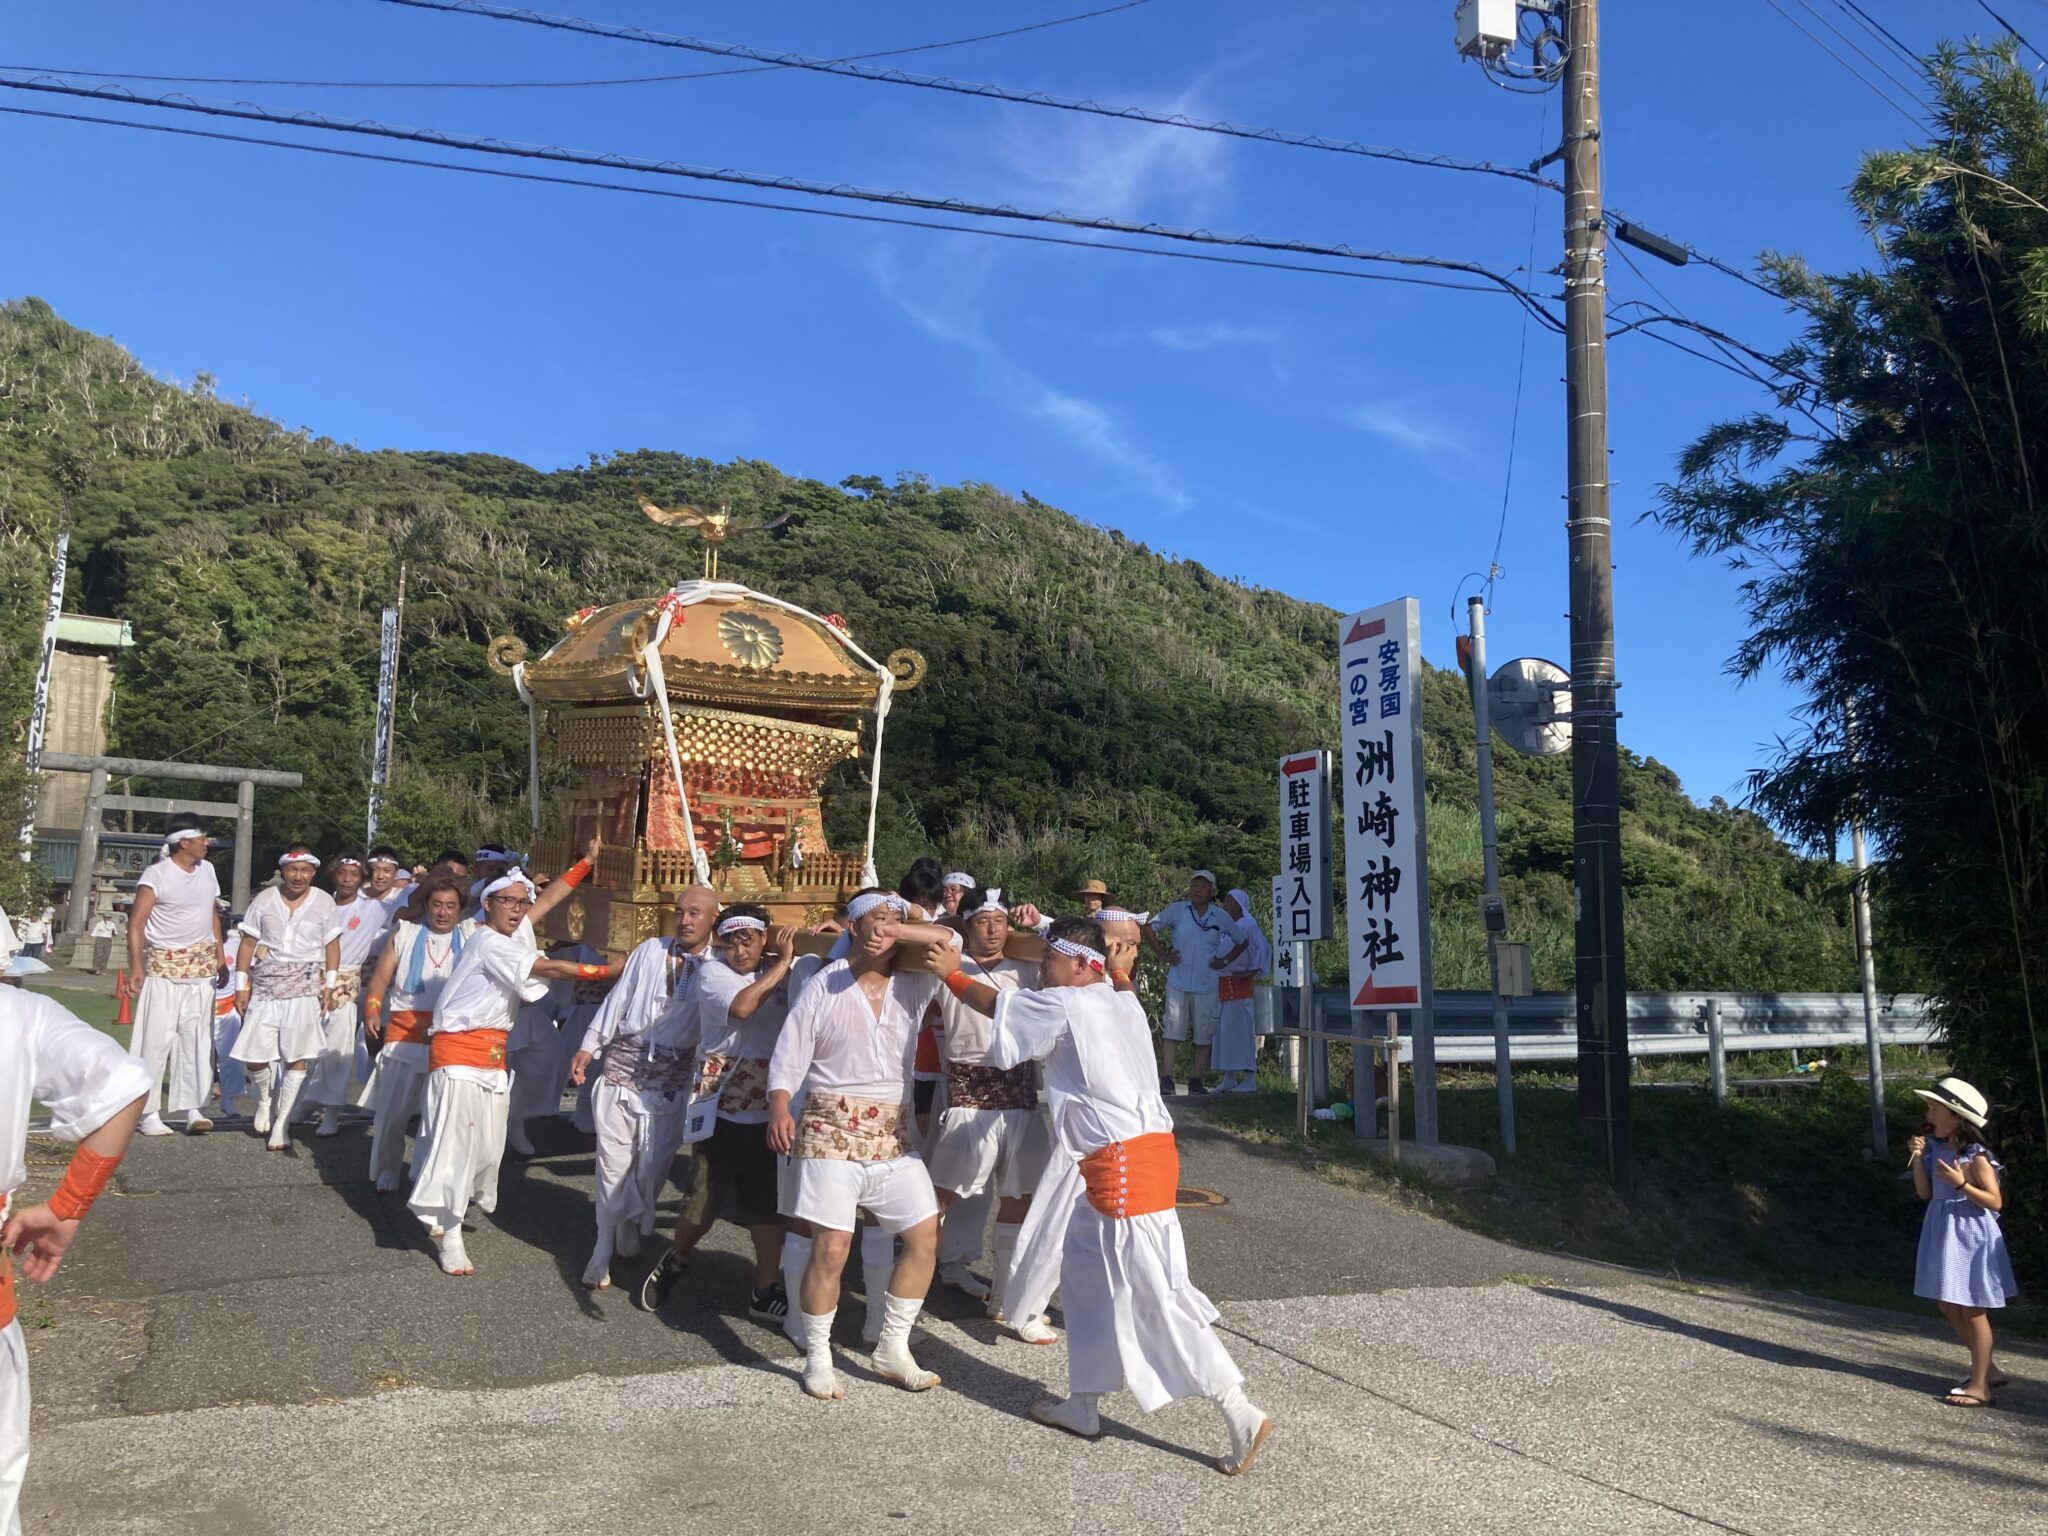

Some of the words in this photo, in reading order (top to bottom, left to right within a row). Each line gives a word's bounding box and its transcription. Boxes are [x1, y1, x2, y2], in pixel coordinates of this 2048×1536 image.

[1347, 657, 1369, 727] 一の宮
[1378, 640, 1401, 719] 安房国
[1288, 778, 1311, 936] 駐車場入口
[1356, 729, 1404, 971] 洲崎神社
